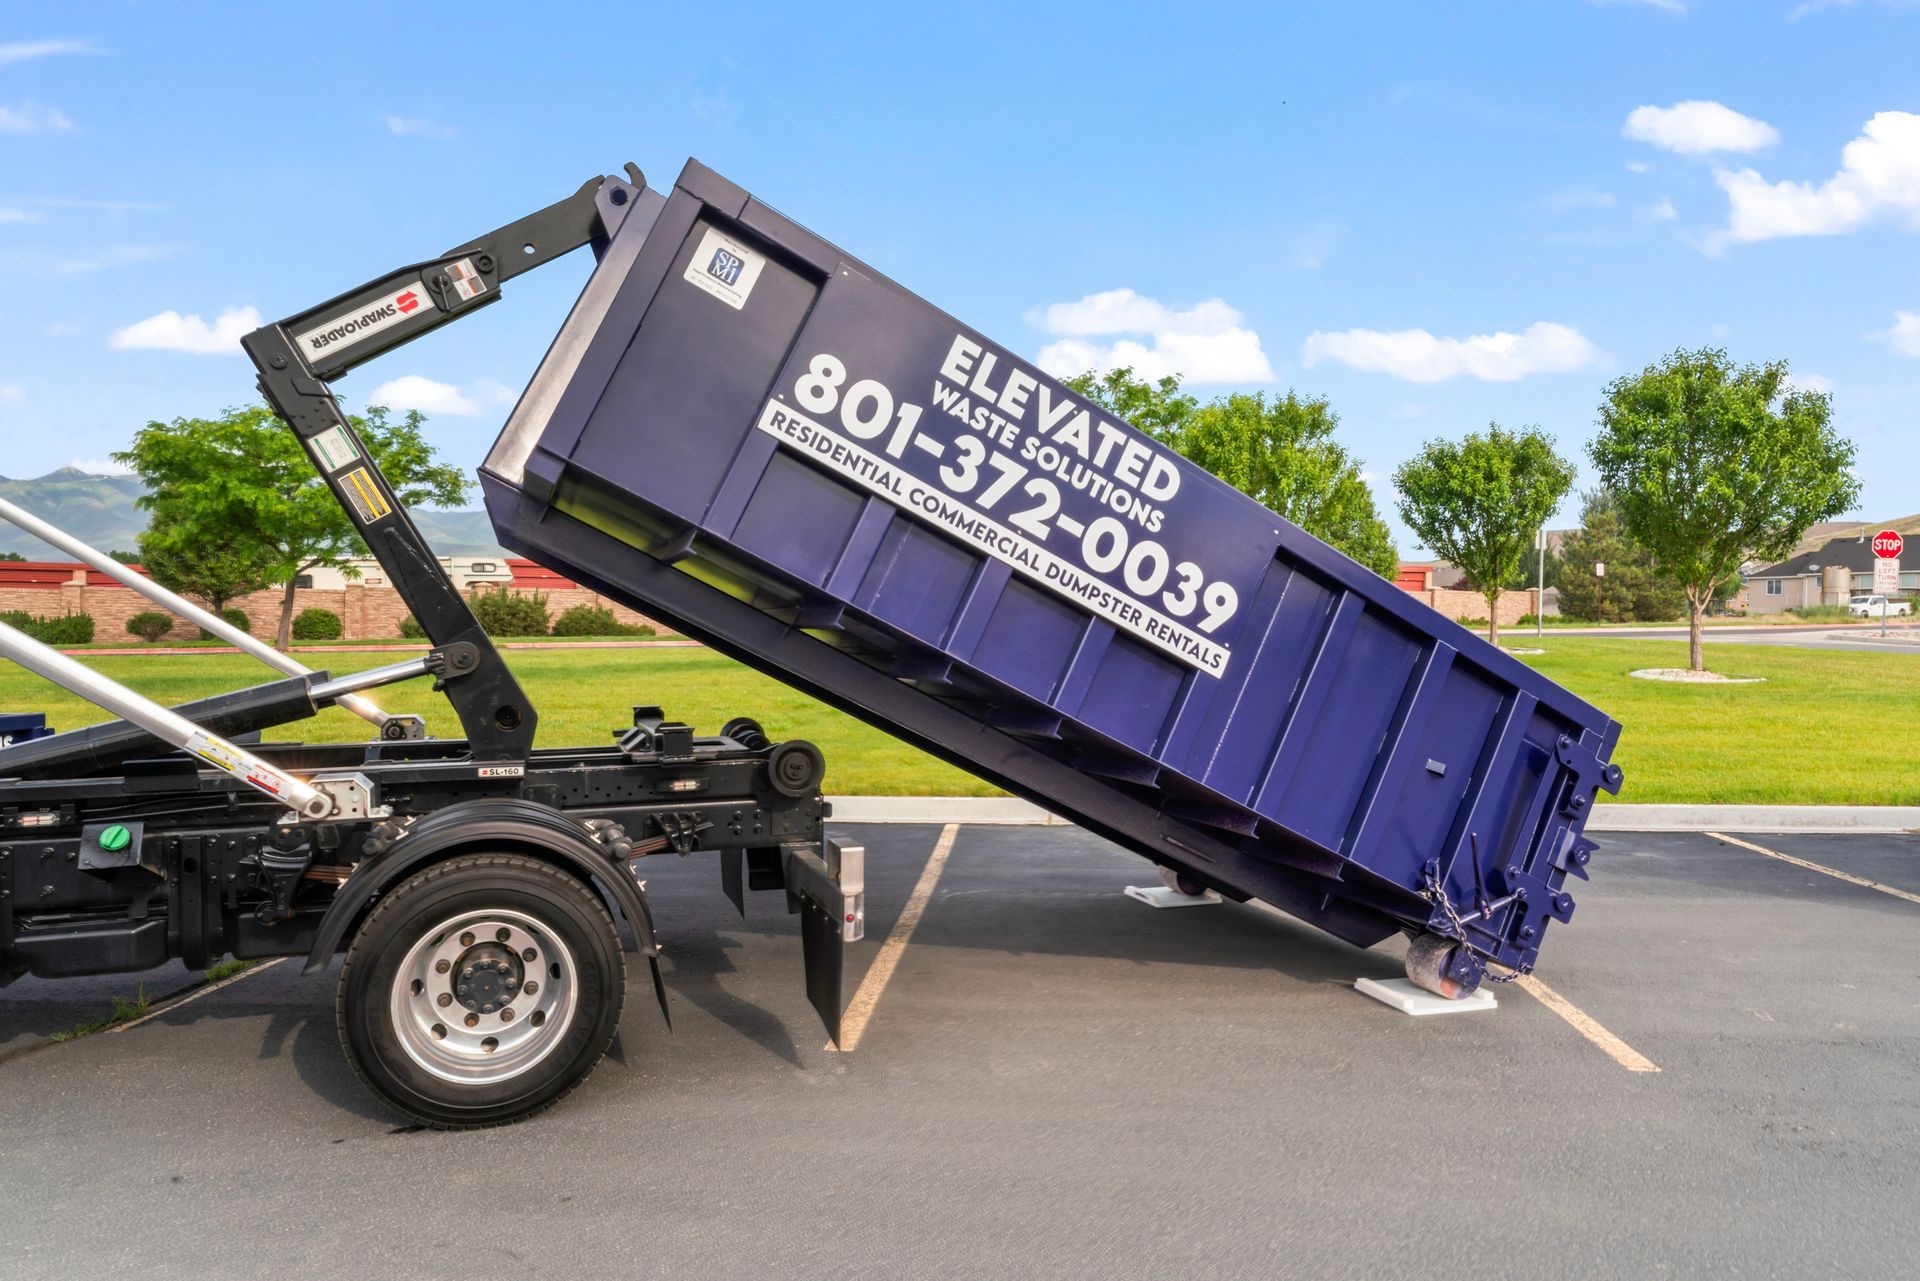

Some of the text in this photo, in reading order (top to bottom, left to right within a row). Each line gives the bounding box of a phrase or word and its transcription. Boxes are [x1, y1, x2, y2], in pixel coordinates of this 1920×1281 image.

[310, 303, 397, 349] SWAPLOADER
[794, 353, 1238, 634] 801-372-0039
[933, 380, 1165, 533] WASTE SOLUTIONS
[940, 333, 1181, 501] ELEVATED
[769, 410, 1222, 669] RESIDENTIAL COMMERCIAL DUMPSTER RENTALS
[1874, 539, 1900, 550] STOP
[489, 768, 519, 776] SL-160
